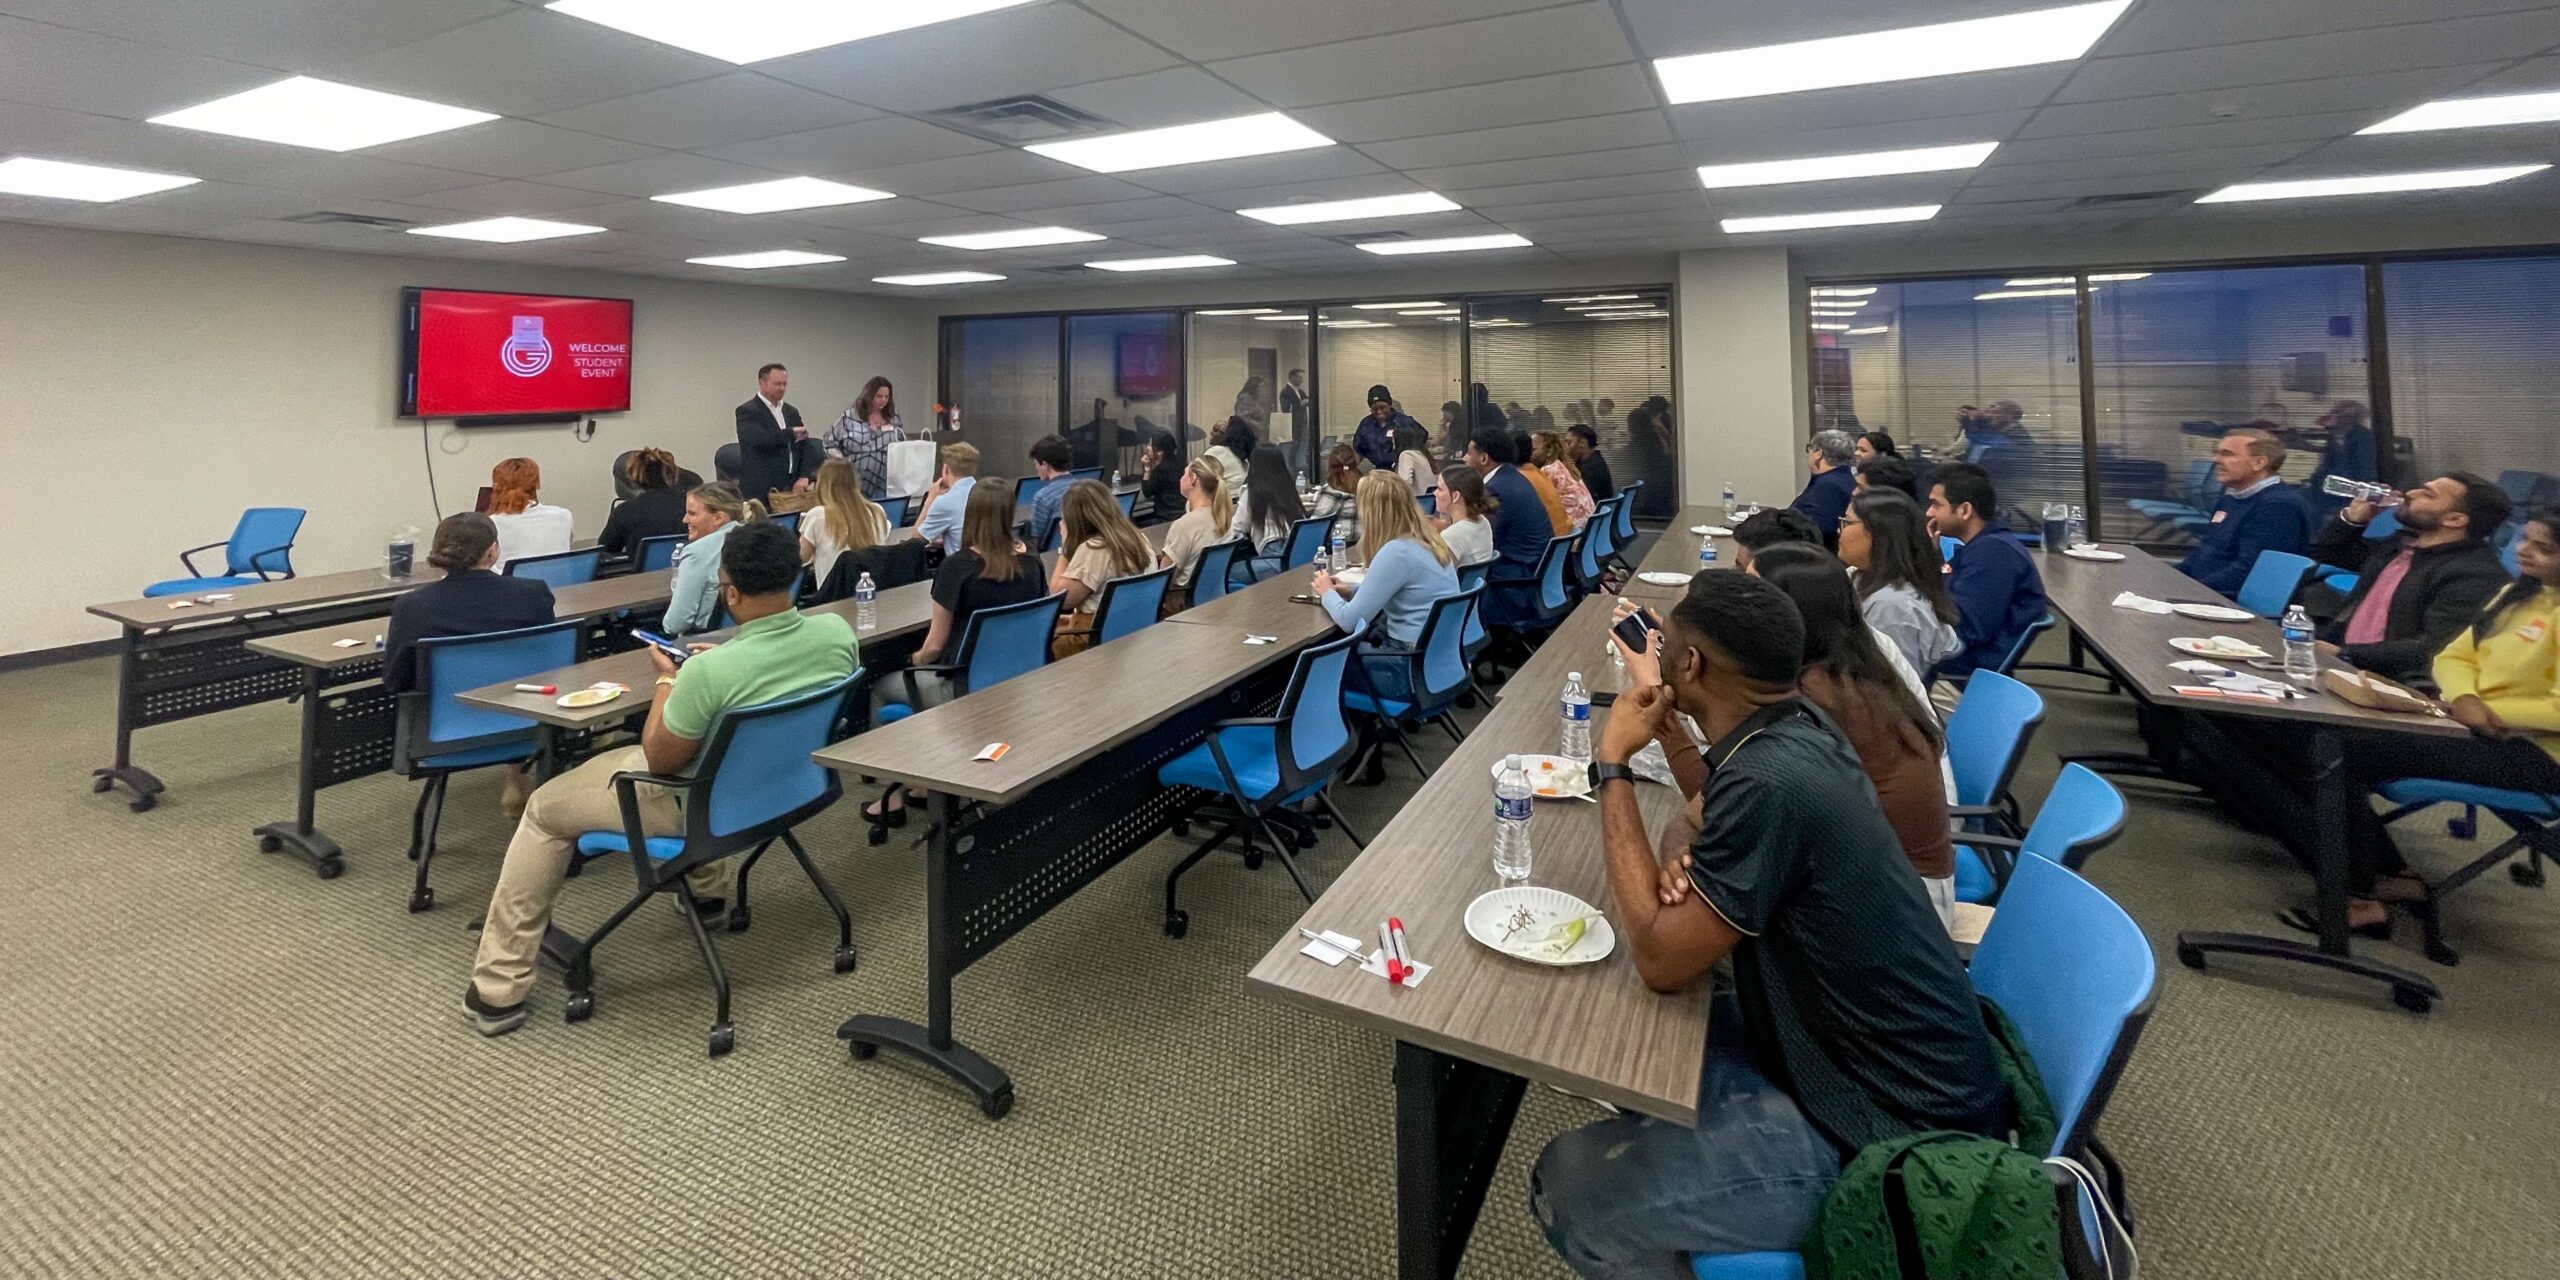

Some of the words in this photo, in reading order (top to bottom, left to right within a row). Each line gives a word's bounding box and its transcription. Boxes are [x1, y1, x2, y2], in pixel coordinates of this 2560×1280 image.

[569, 343, 627, 353] WELCOME
[574, 358, 623, 367] STUDENT
[581, 368, 616, 378] EVENT
